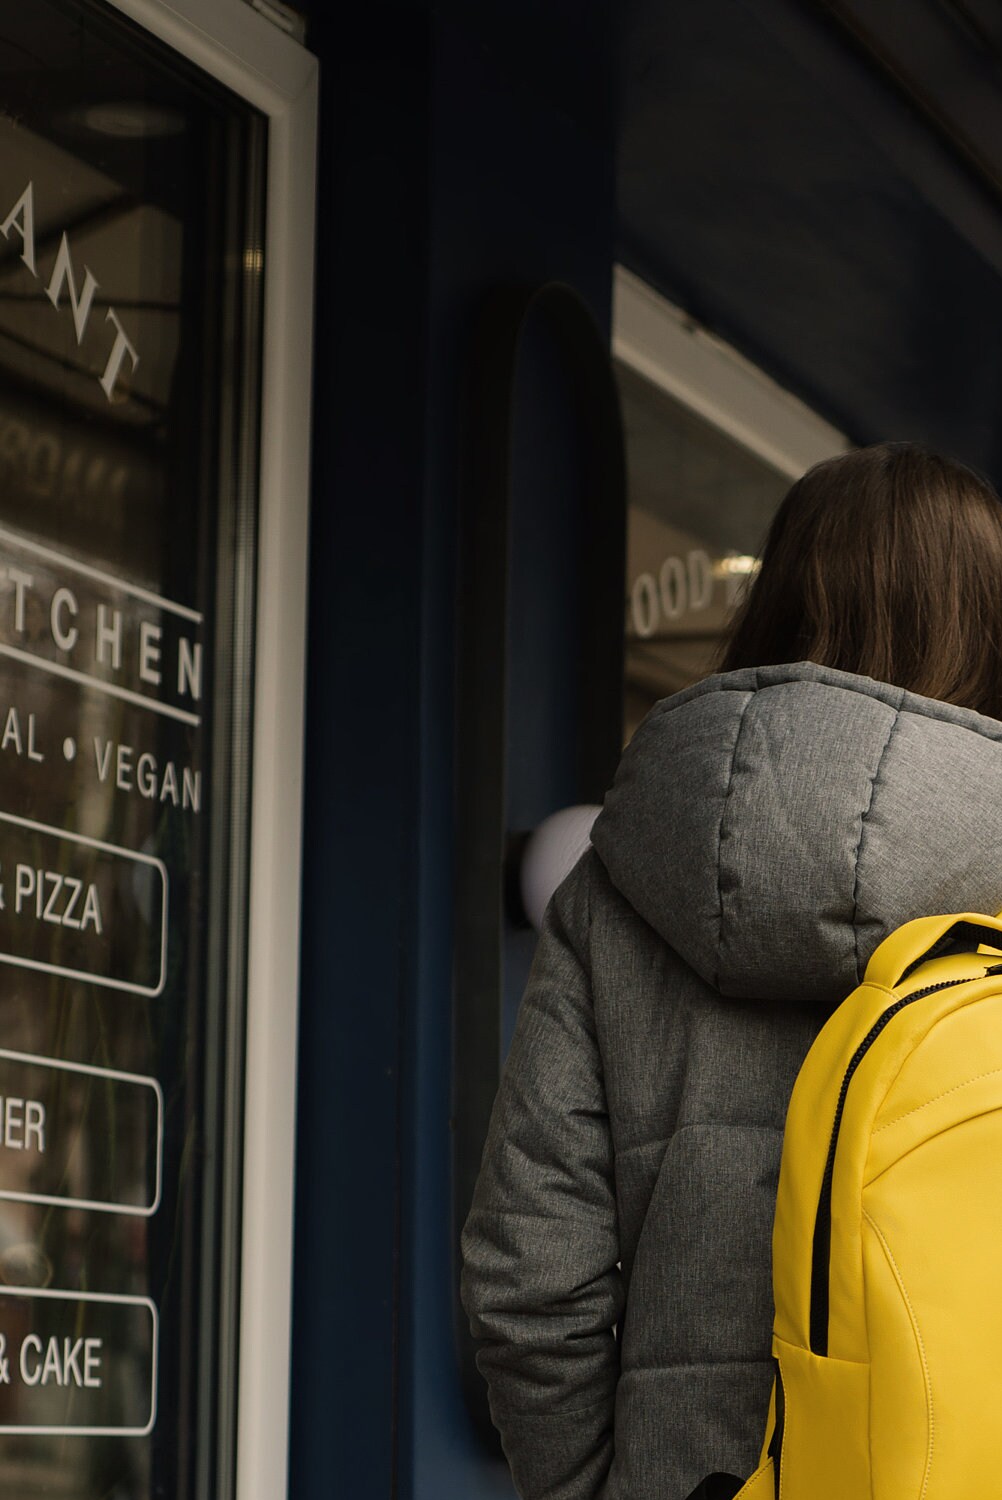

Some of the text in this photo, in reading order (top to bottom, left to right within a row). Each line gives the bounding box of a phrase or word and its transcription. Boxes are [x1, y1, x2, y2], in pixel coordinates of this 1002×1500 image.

[0, 181, 139, 401] ANT
[8, 567, 202, 700] TCHEN
[1, 707, 201, 813] AL VEGAN
[15, 863, 103, 935] PIZZA
[0, 1096, 46, 1154] ER
[20, 1333, 103, 1388] CAKE
